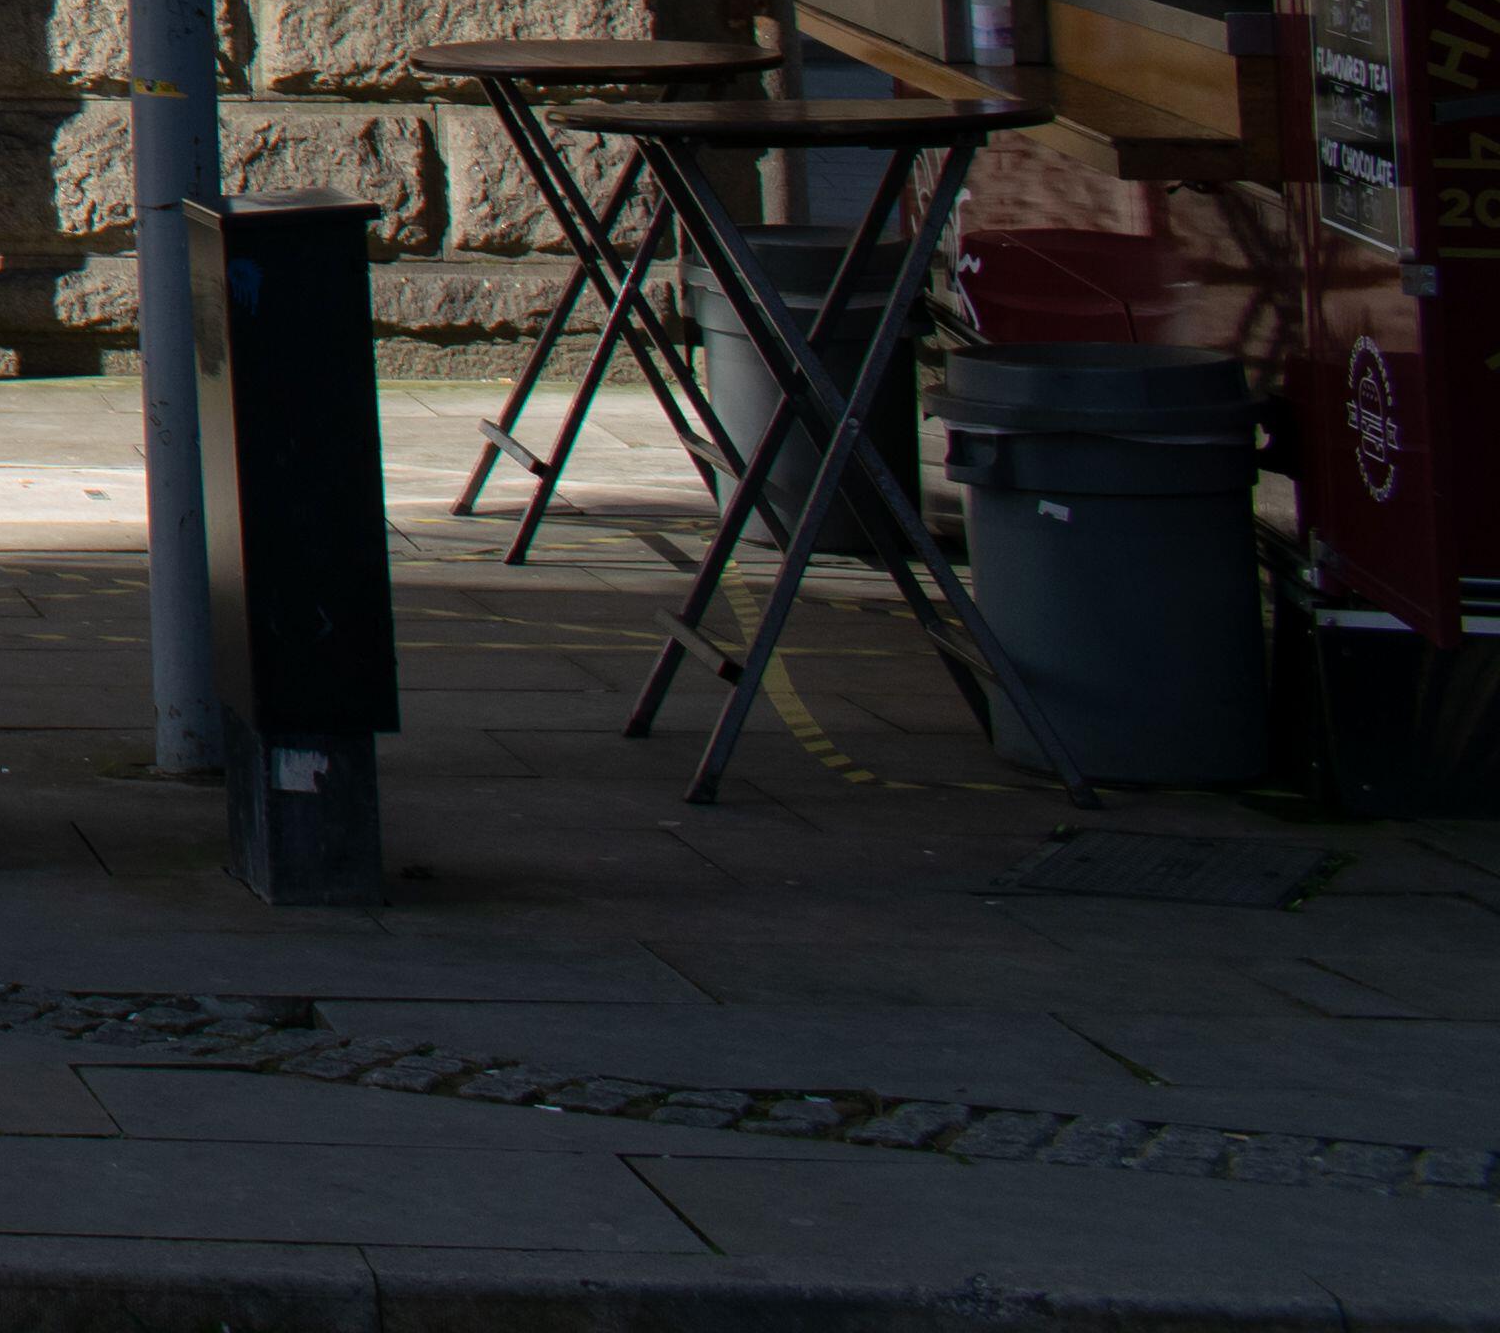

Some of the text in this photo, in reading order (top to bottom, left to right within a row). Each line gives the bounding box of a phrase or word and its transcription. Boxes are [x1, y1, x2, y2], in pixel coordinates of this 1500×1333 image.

[1315, 46, 1390, 94] FLAVOURED TEA
[1321, 136, 1396, 185] HOT CHOCOLATE
